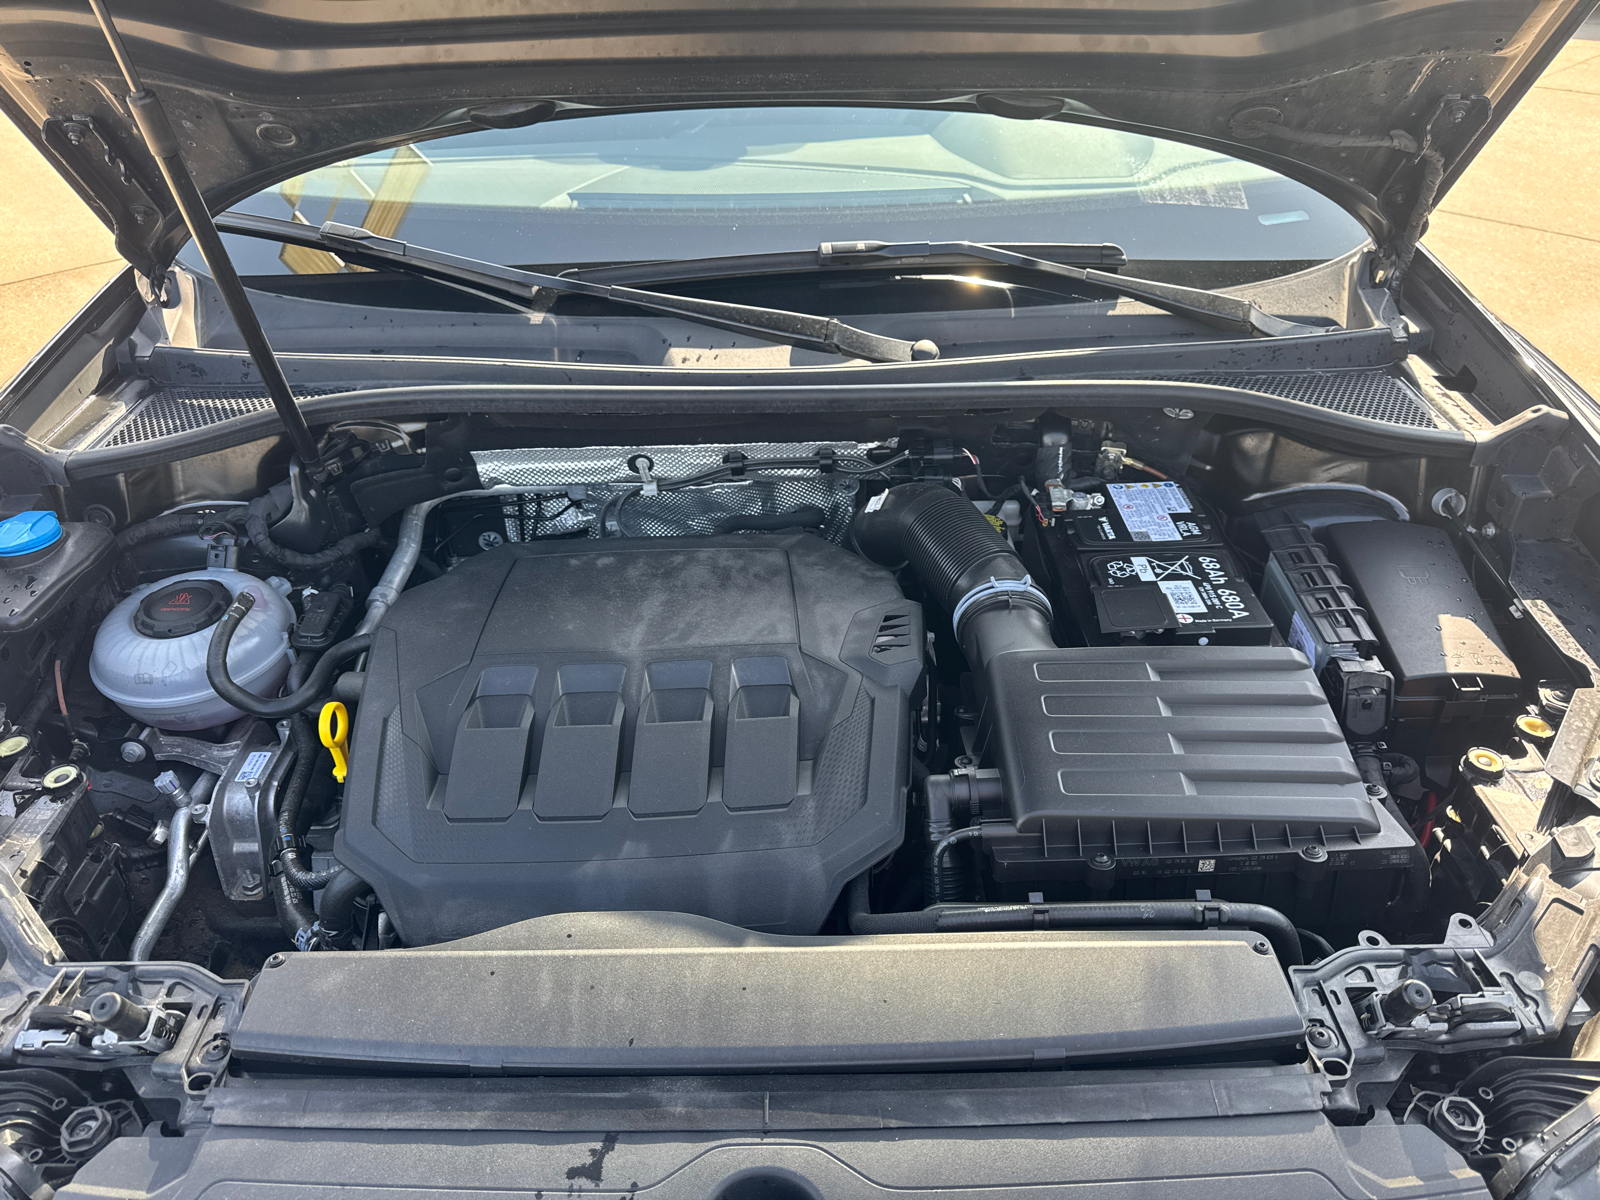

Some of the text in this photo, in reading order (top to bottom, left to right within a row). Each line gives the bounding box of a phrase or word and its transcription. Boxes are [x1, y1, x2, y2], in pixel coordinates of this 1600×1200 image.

[1176, 521, 1191, 537] VRLA
[1186, 522, 1202, 535] AGM
[1137, 564, 1148, 574] Pb
[1198, 556, 1229, 584] 68Ah
[1217, 588, 1250, 619] 680A
[1121, 859, 1140, 867] VW
[1141, 858, 1160, 867] AG
